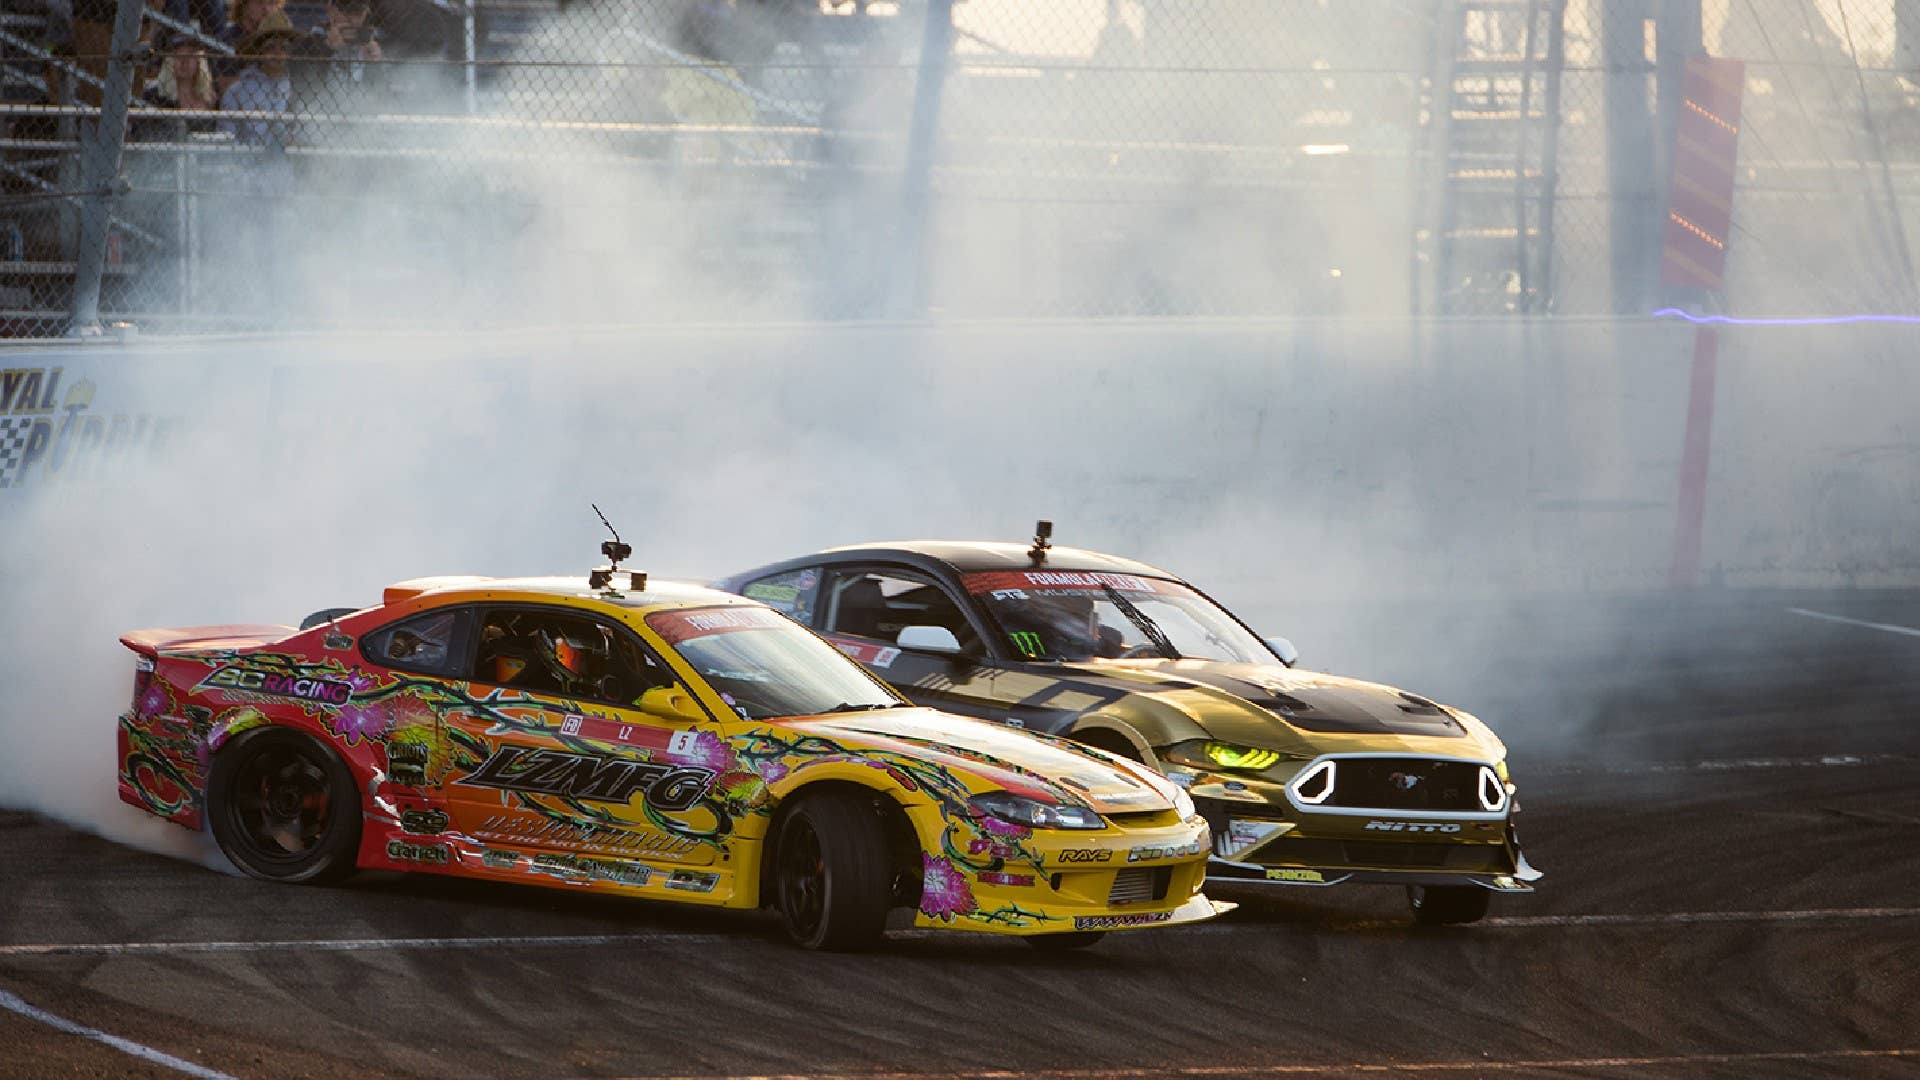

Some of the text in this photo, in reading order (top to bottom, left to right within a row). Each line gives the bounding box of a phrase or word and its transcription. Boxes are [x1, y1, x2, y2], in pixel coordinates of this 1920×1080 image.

[0, 367, 64, 415] YAL
[263, 672, 348, 701] RACING
[678, 735, 689, 750] 5
[452, 745, 716, 811] LZMFG
[1363, 820, 1461, 833] NITTO
[1058, 849, 1113, 863] RAYS
